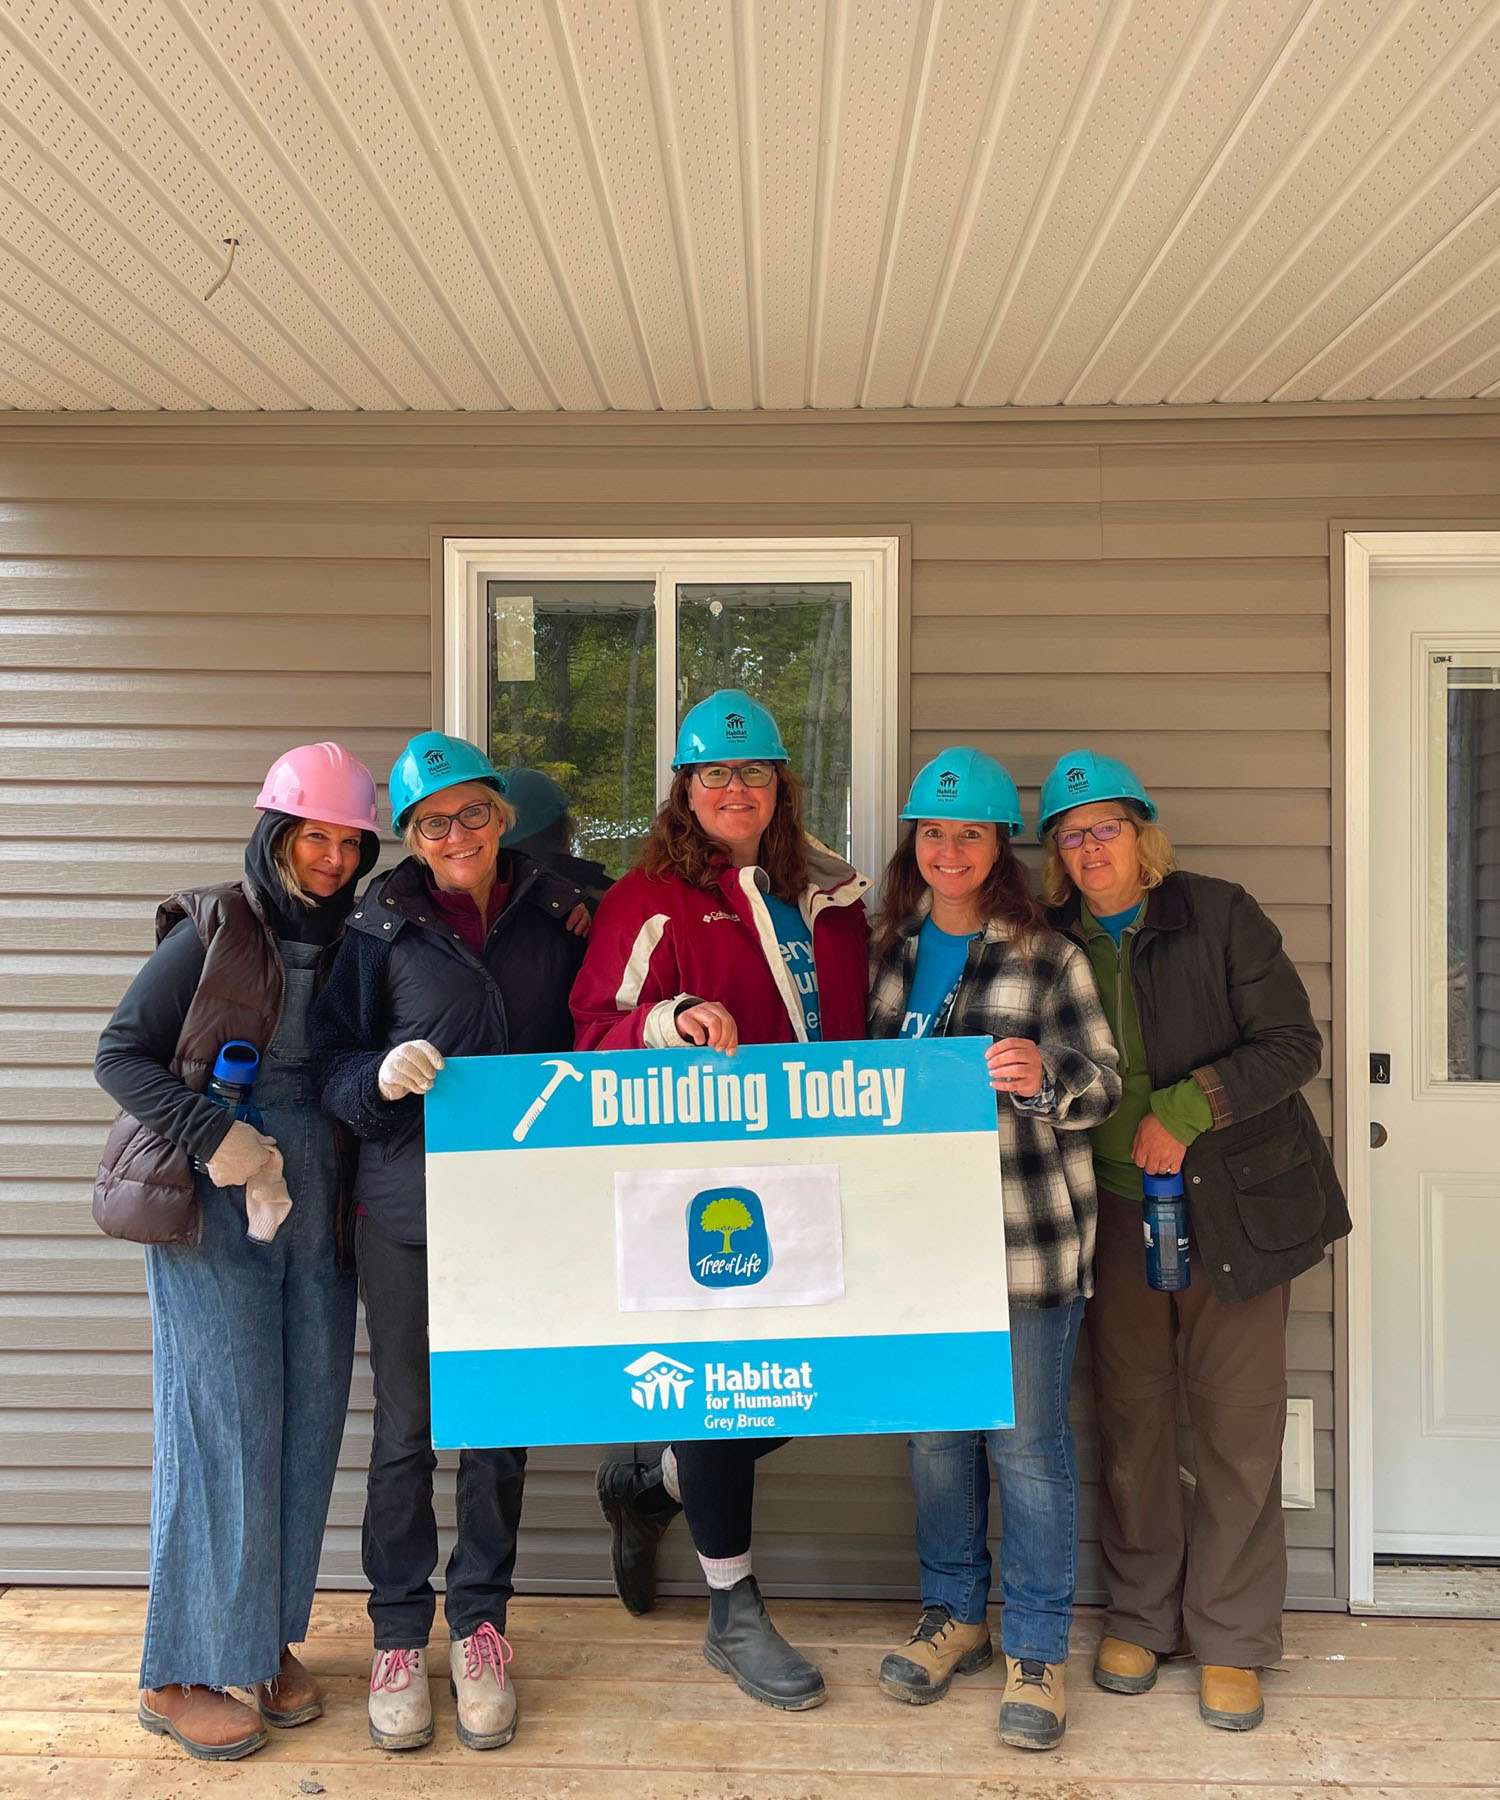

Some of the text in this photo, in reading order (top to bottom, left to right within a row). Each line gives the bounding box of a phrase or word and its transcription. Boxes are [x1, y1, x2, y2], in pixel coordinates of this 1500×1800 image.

[591, 1060, 905, 1131] Building Today
[696, 1253, 762, 1277] Tree of Life
[704, 1361, 813, 1391] Habitat
[705, 1393, 730, 1410] for
[704, 1414, 776, 1431] Grey Bruce
